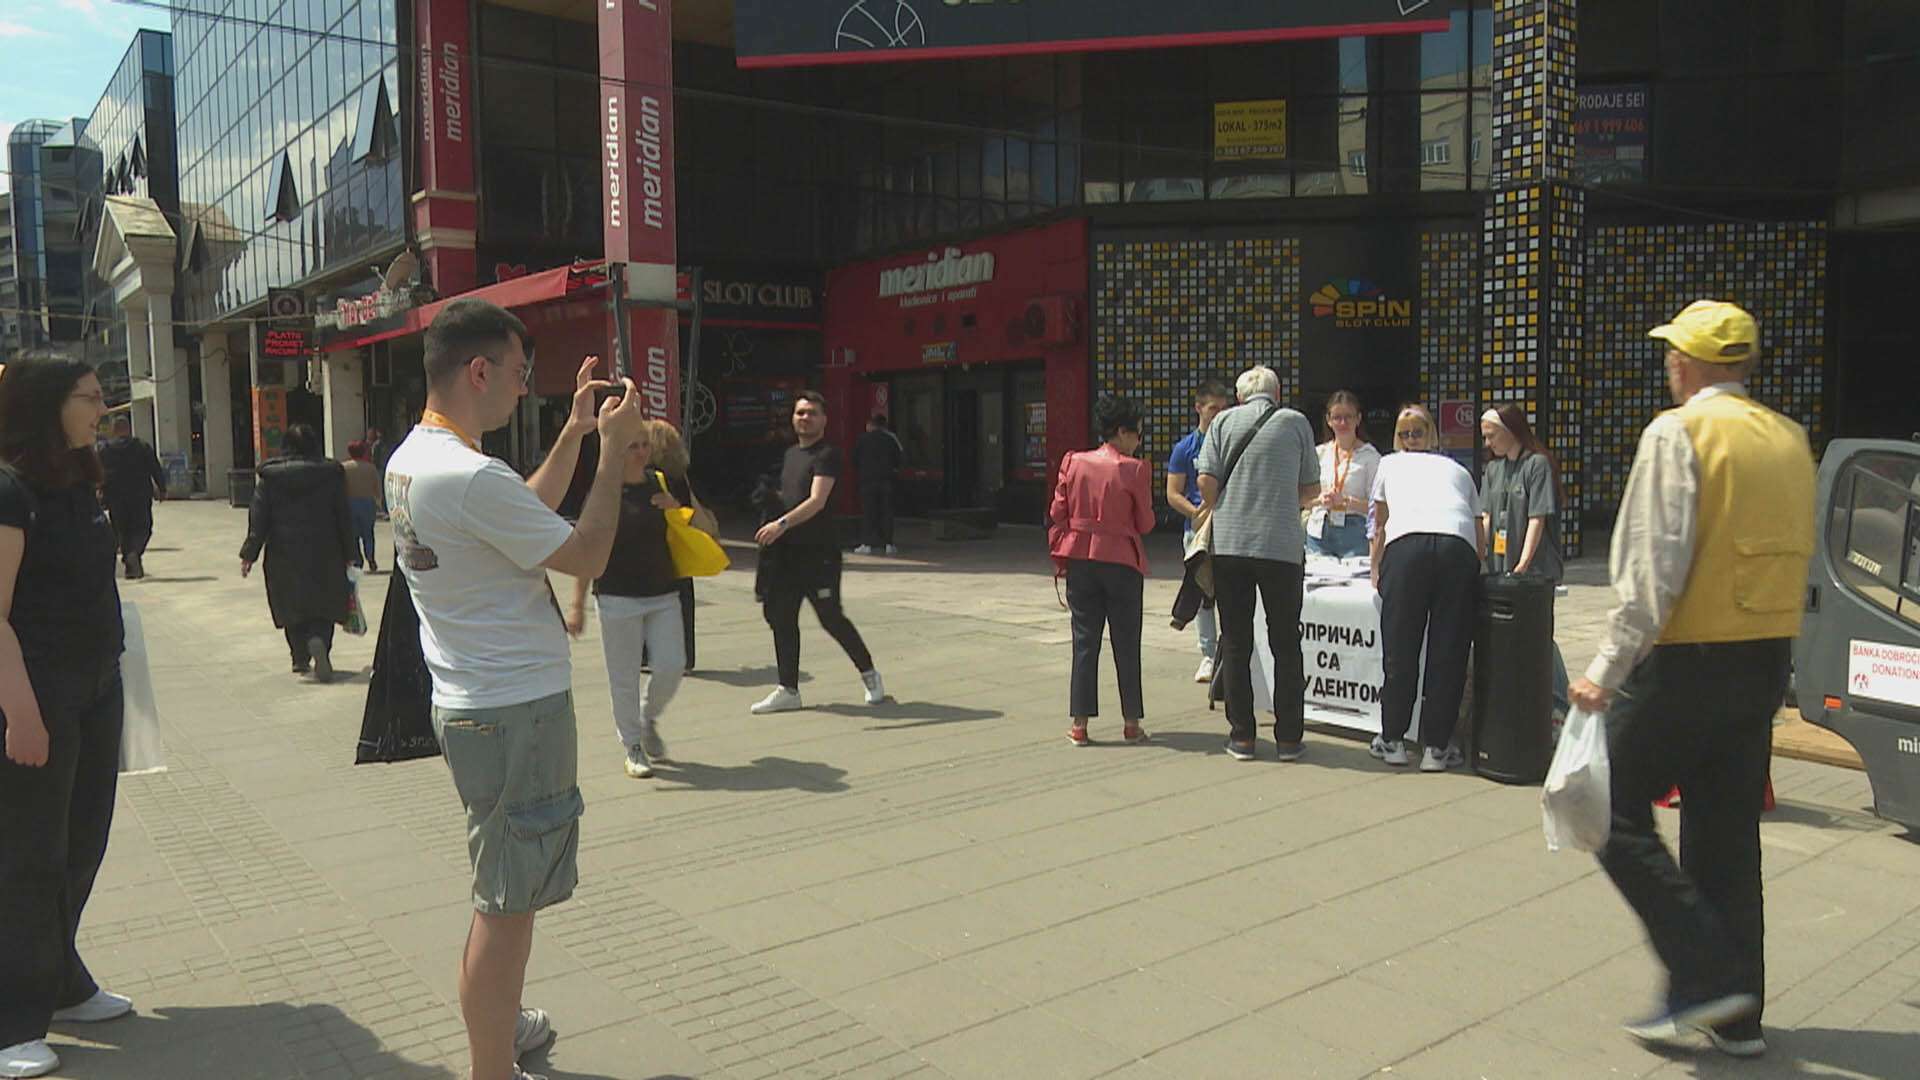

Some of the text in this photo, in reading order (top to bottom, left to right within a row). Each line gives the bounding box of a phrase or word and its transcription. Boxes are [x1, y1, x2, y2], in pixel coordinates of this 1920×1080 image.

[440, 42, 462, 142] meridian
[1218, 121, 1247, 133] LOKAL
[606, 96, 620, 228] meridian
[635, 96, 662, 229] meridian
[879, 247, 995, 297] meridian
[703, 279, 814, 308] SLOT CLUB
[1336, 319, 1410, 328] SLOT CLUB
[642, 346, 668, 420] idian
[1317, 651, 1341, 671] СА
[1853, 645, 1880, 659] BANKA
[1872, 663, 1920, 680] DONATION
